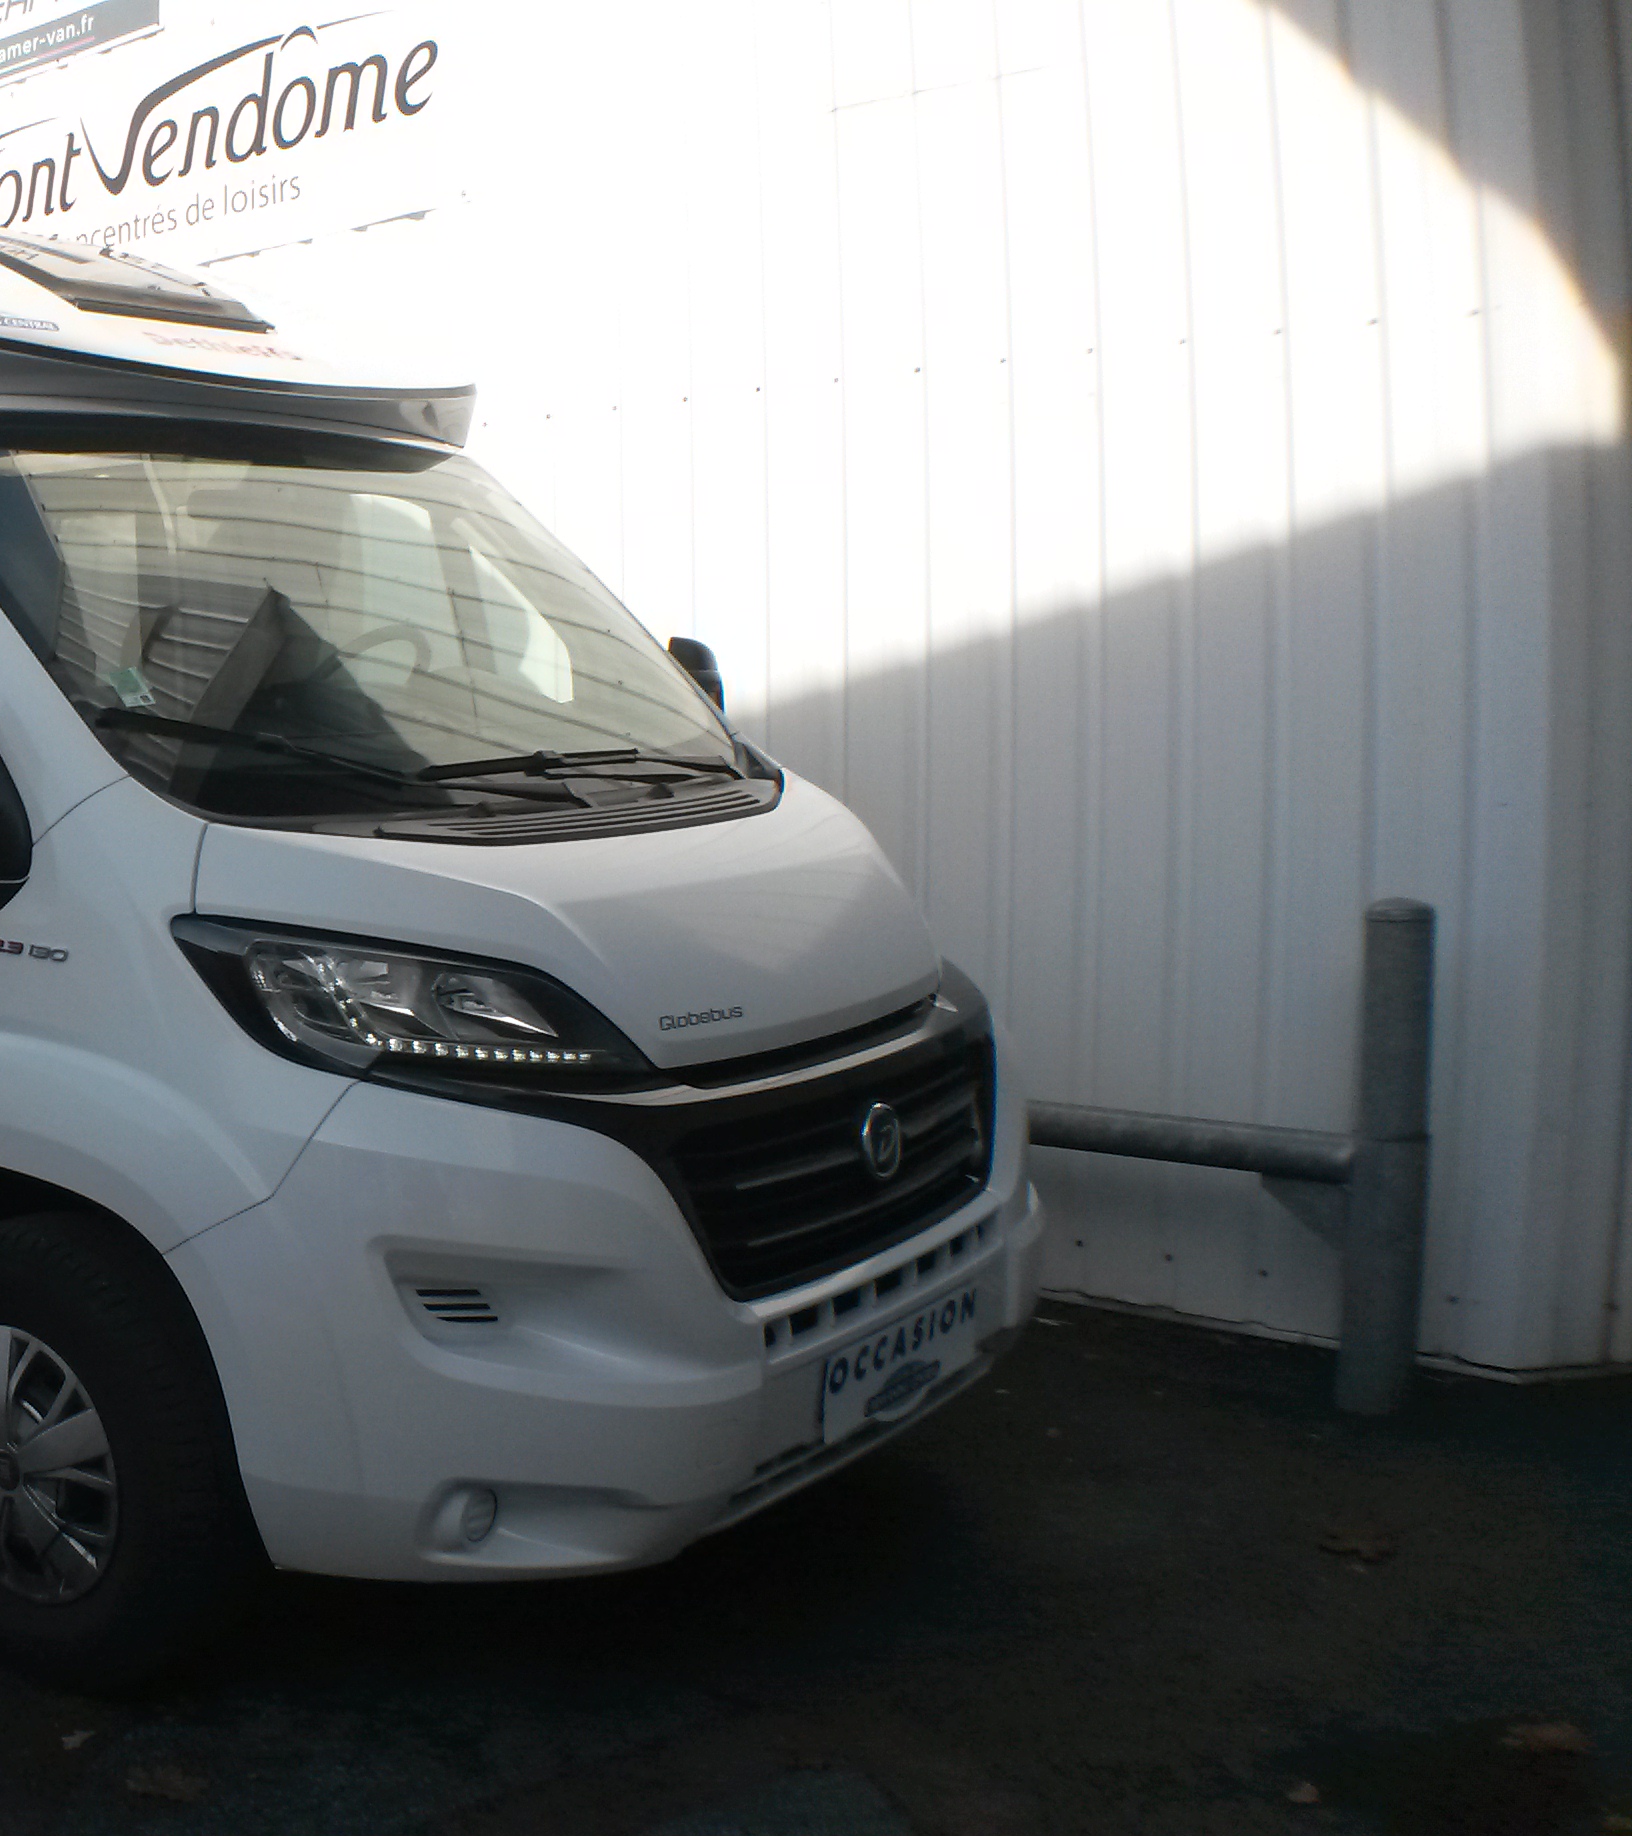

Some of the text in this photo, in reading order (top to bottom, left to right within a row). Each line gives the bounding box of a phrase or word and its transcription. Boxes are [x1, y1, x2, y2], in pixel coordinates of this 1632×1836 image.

[186, 193, 215, 226] de
[224, 174, 300, 215] loisirs
[658, 1005, 744, 1031] Globebus
[829, 1288, 977, 1394] OCCASION
